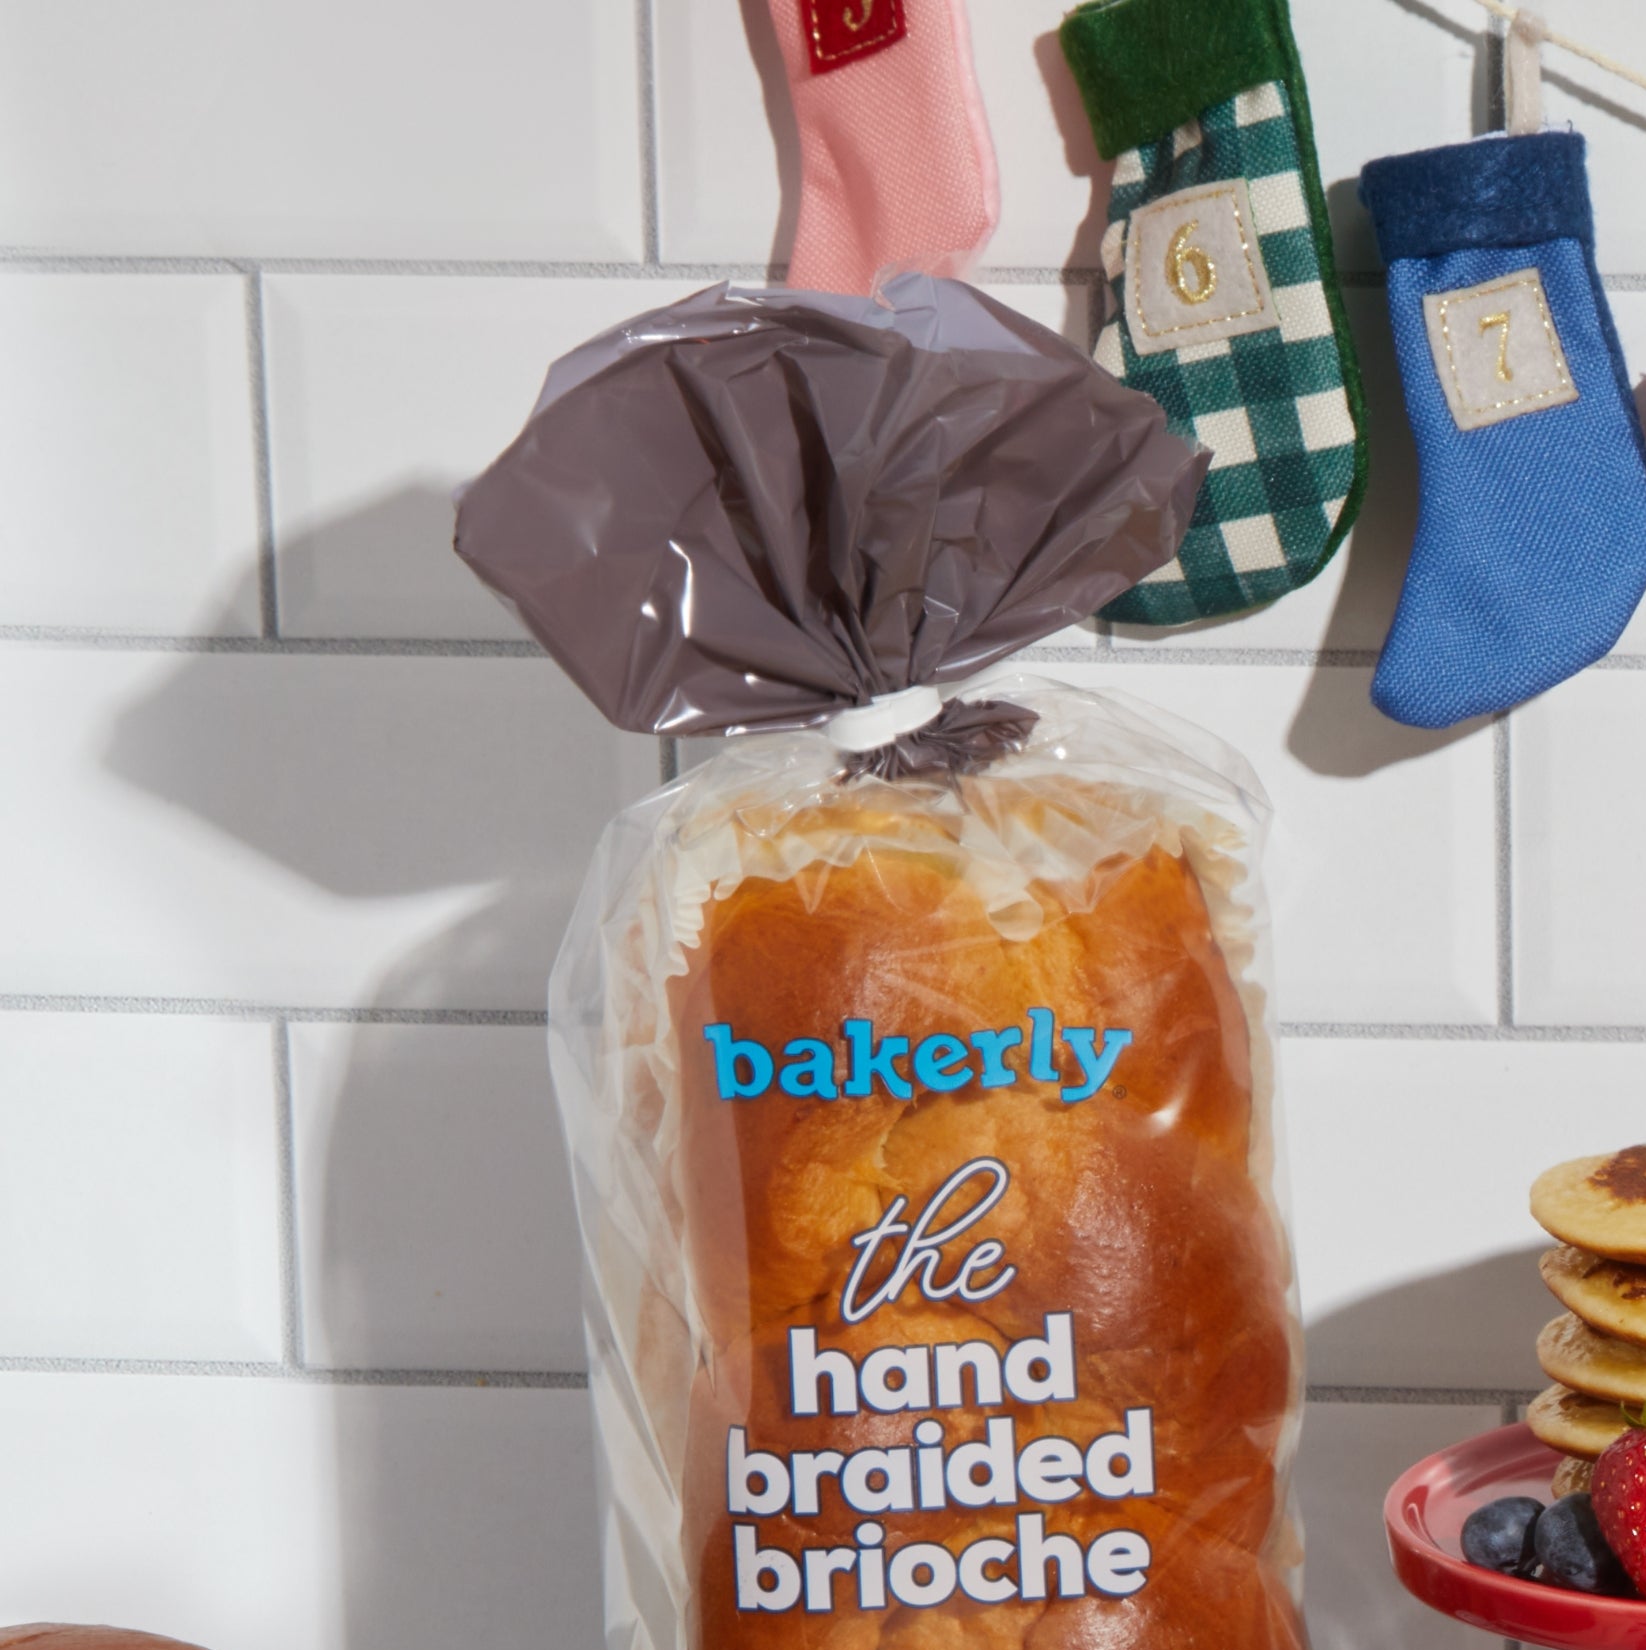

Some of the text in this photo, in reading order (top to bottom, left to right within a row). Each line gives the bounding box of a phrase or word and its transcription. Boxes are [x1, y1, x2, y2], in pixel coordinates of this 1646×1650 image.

[1164, 220, 1217, 306] 6
[1479, 310, 1513, 382] 7
[704, 1007, 1133, 1102] bakerly
[840, 1156, 1016, 1325] the
[788, 1312, 1077, 1415] hand
[726, 1408, 1155, 1520] braided
[733, 1512, 1151, 1614] brioche
